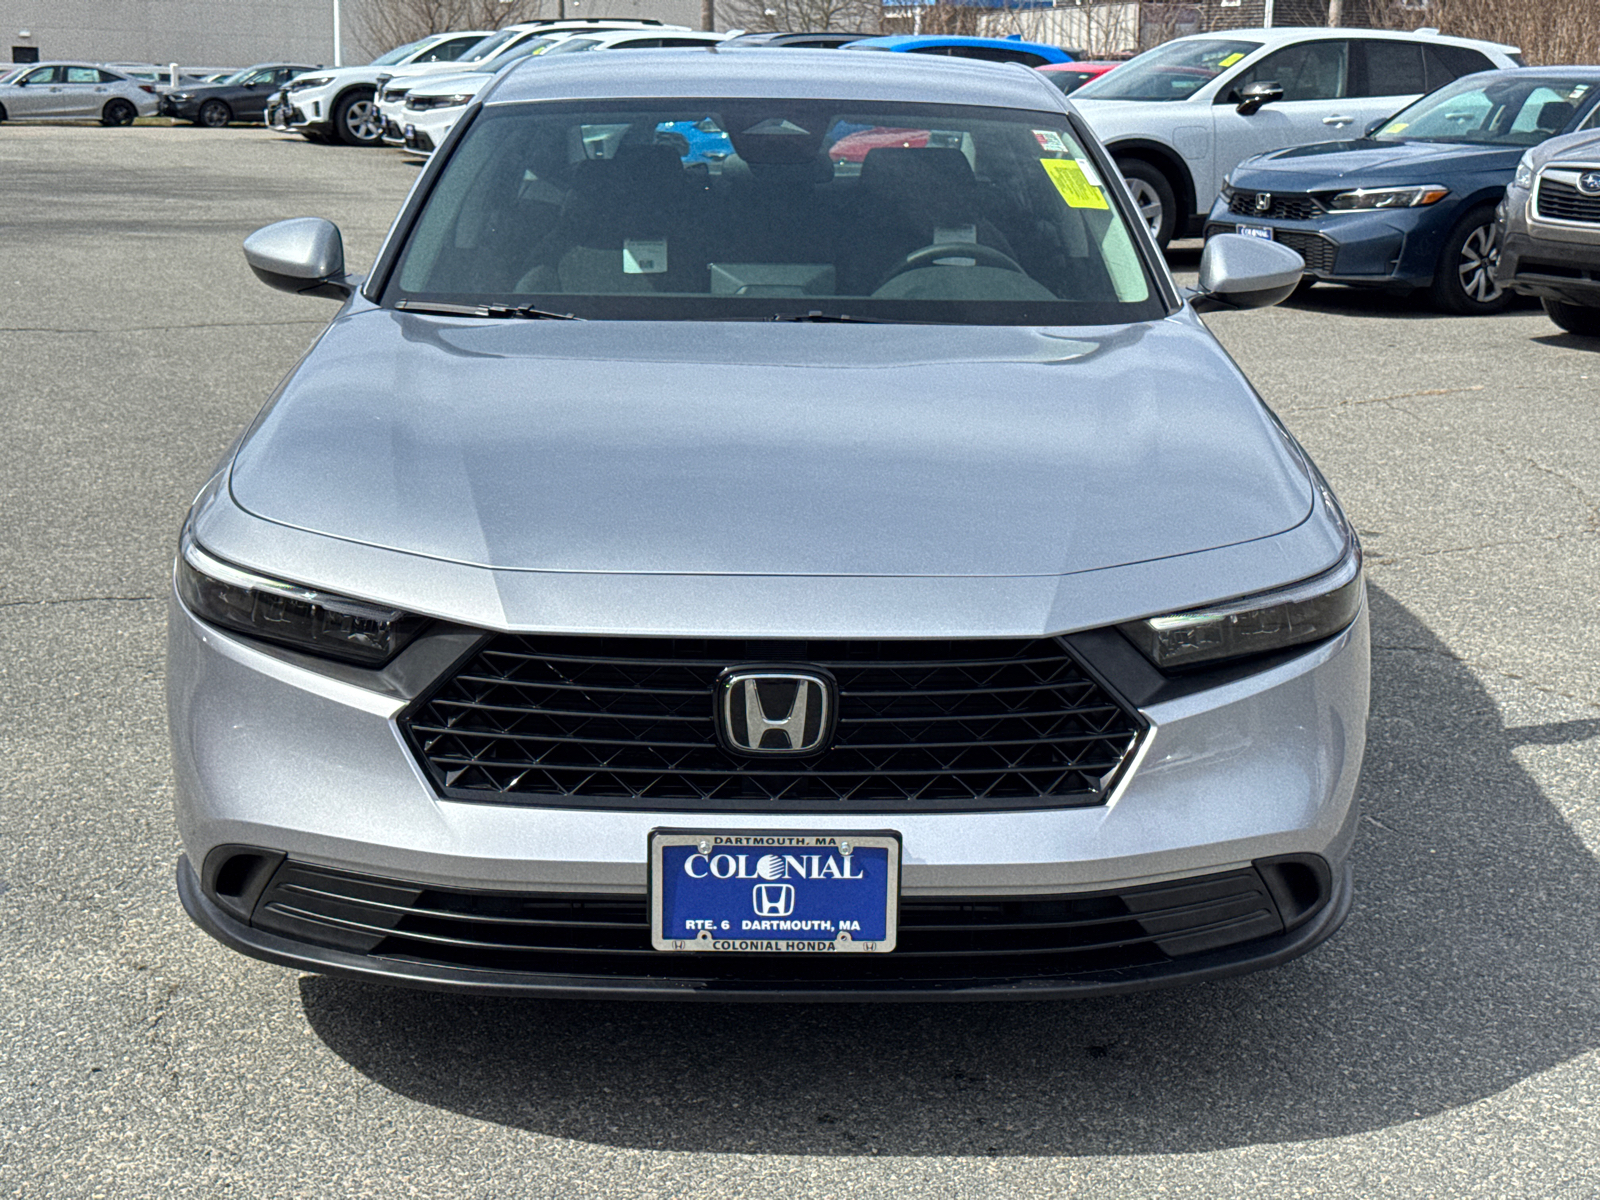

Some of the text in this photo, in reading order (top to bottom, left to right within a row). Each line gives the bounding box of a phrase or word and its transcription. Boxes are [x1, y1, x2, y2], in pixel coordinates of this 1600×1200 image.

[815, 838, 837, 846] MA
[684, 854, 863, 880] COLONIAL
[685, 920, 861, 932] RTE. 6 DARTMOUTH, MA
[712, 941, 836, 951] COLONIAL HONDA
